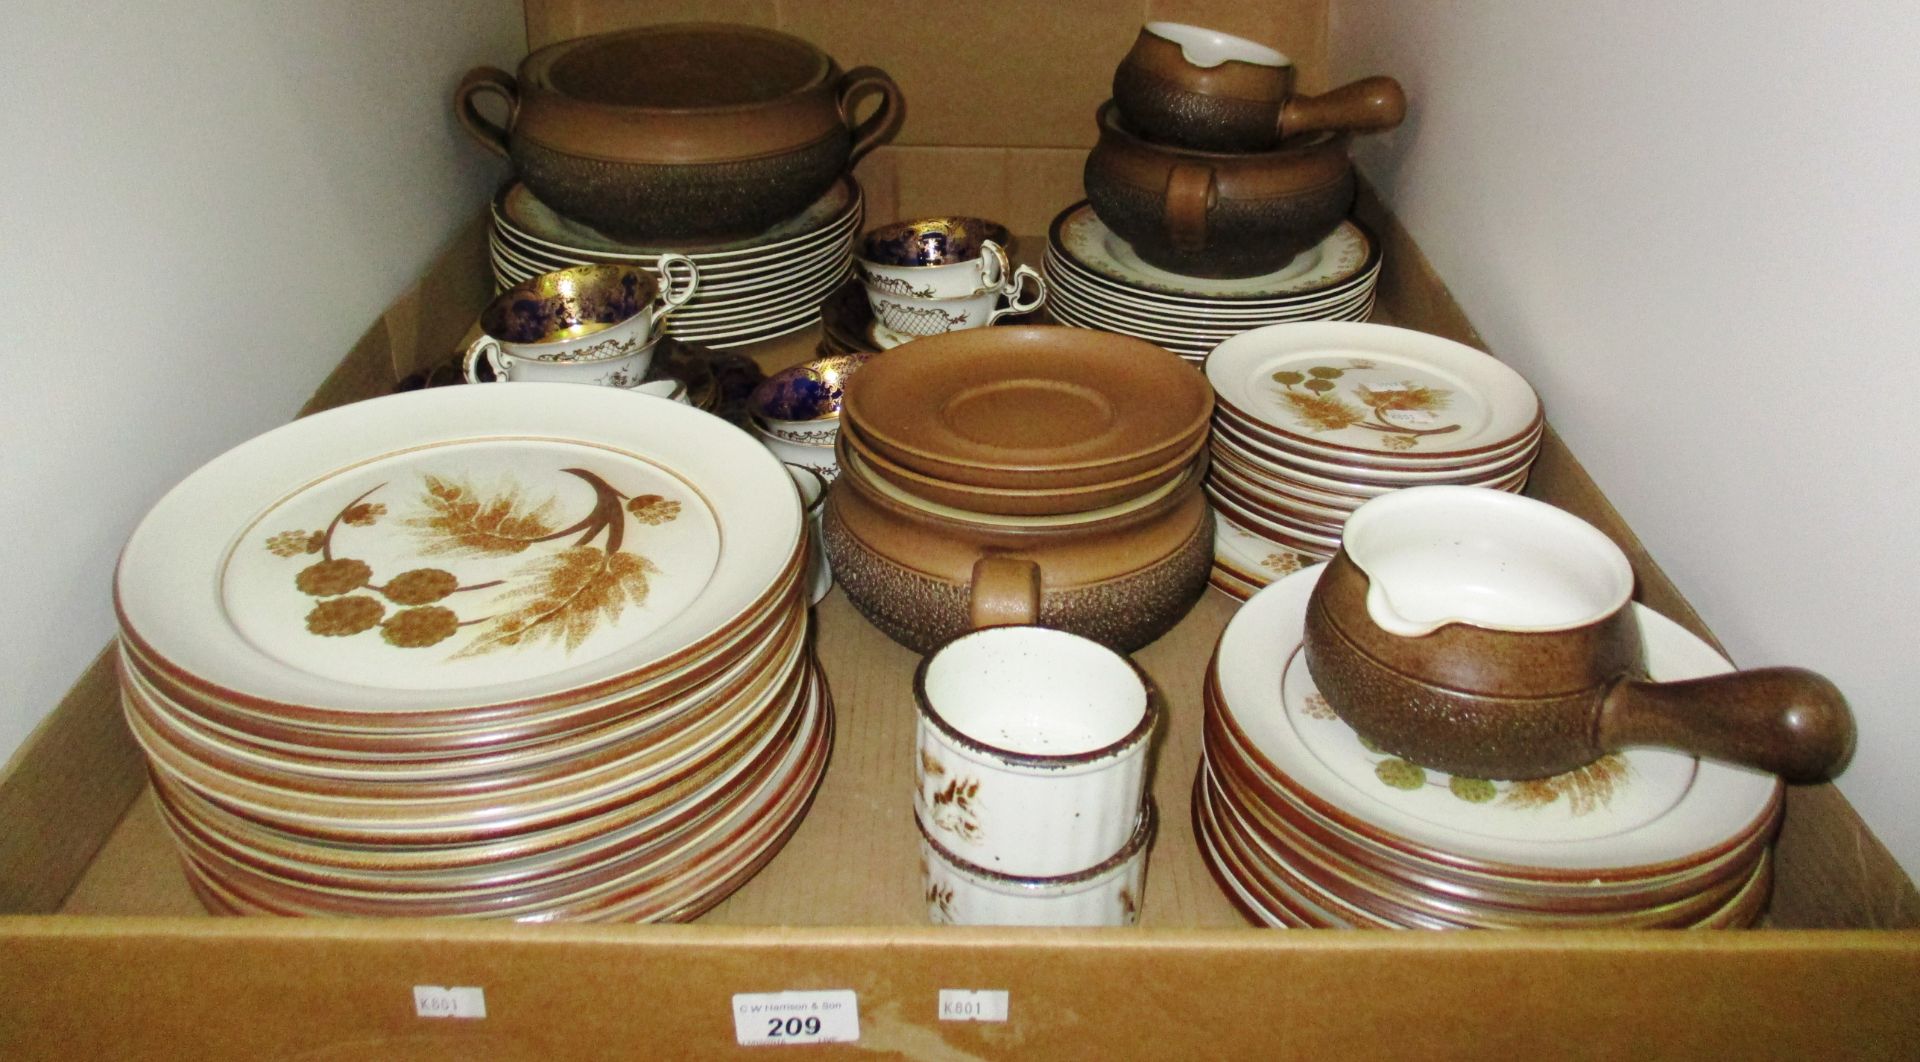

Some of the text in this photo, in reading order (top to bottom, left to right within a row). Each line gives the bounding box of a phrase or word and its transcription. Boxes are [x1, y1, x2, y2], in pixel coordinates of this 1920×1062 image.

[751, 1004, 762, 1013] W
[765, 1002, 808, 1013] Harrison
[811, 1001, 819, 1010] &
[822, 1001, 842, 1010] Son
[944, 1001, 980, 1015] K801
[767, 1016, 822, 1037] 209
